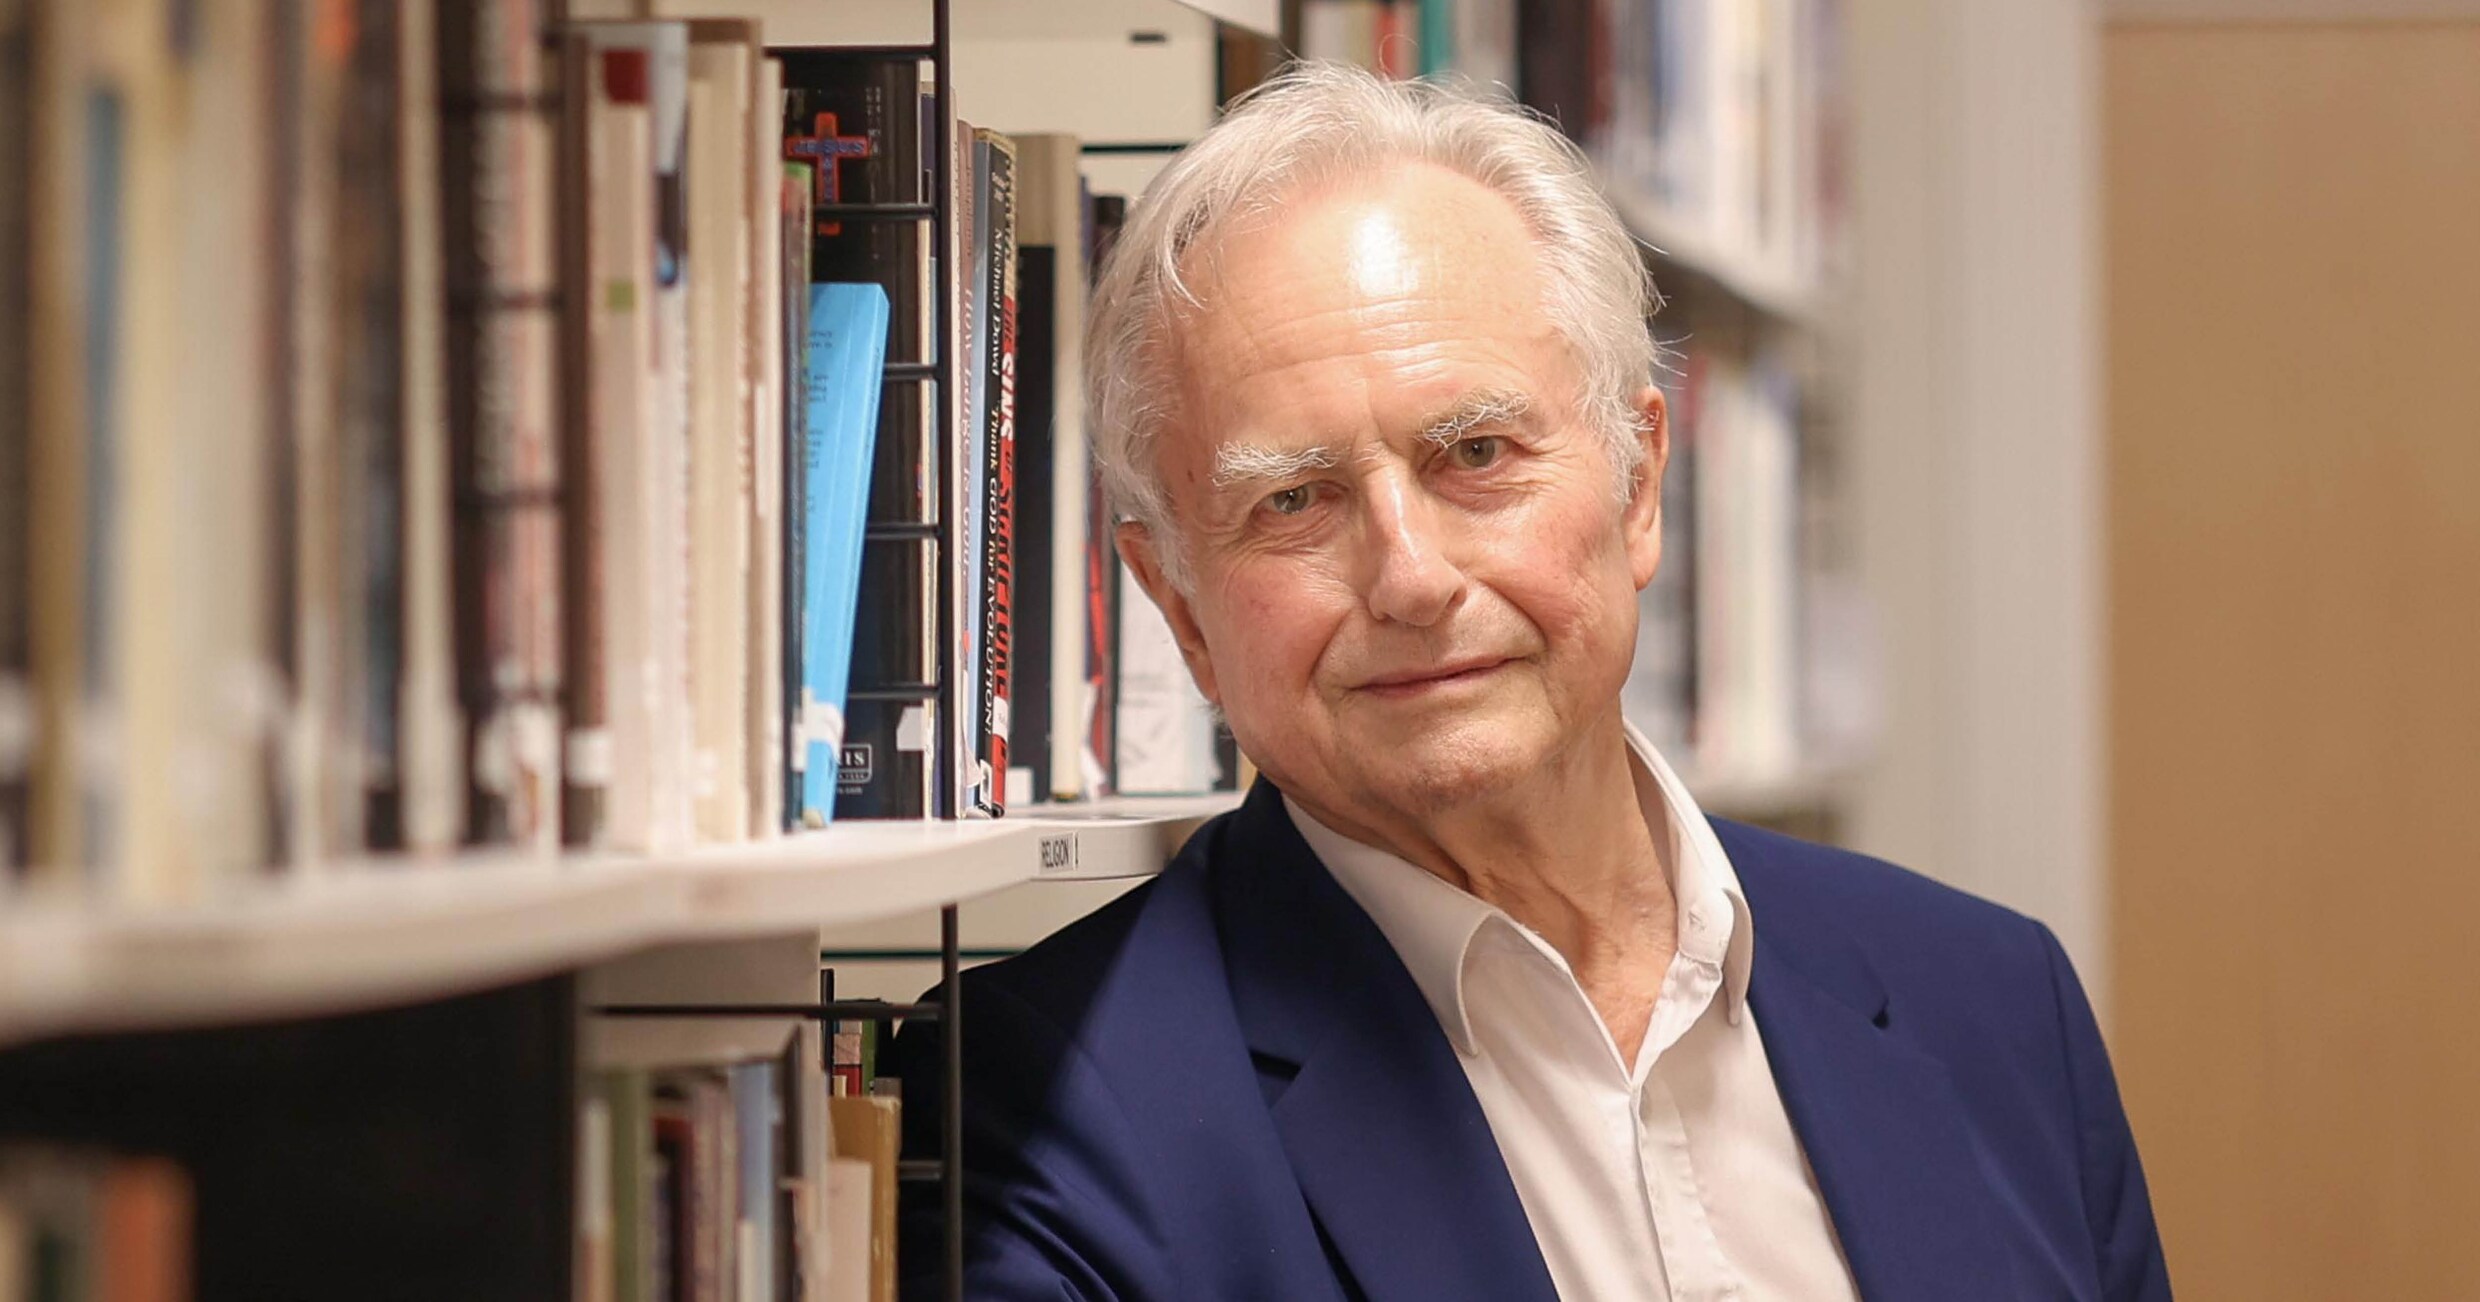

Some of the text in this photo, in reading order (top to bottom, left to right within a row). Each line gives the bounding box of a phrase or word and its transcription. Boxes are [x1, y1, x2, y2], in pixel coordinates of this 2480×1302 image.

[793, 138, 863, 153] JESUS
[992, 228, 1002, 376] Michael Dowd
[1001, 351, 1014, 442] SINS
[984, 406, 999, 735] Thank GOD for EVOLUTION!
[995, 480, 1011, 699] SCRIPTURE
[1041, 837, 1069, 868] RELIGION
